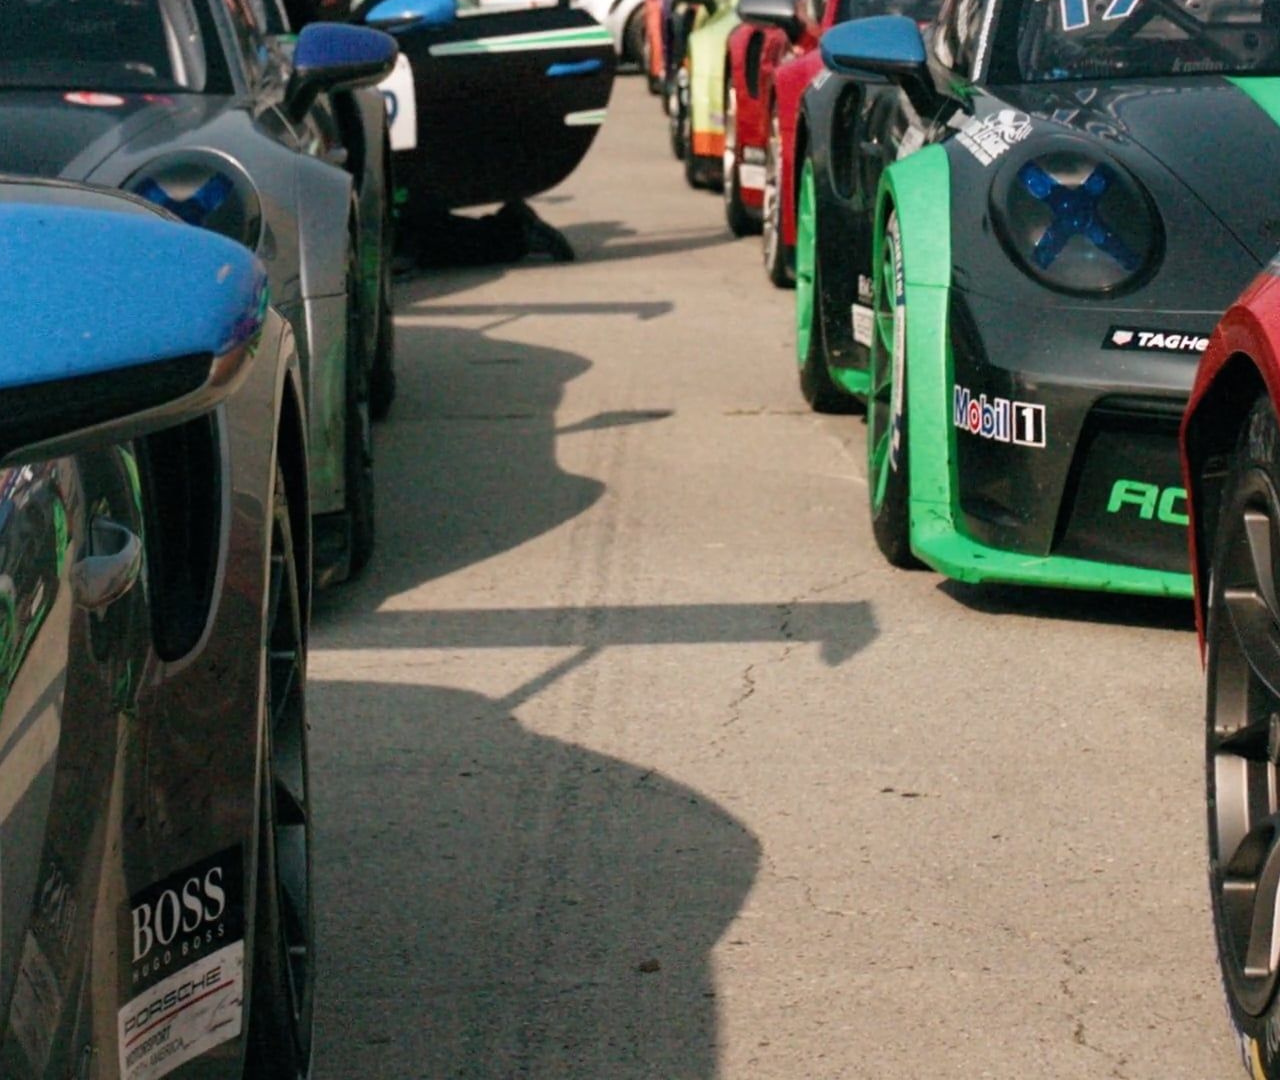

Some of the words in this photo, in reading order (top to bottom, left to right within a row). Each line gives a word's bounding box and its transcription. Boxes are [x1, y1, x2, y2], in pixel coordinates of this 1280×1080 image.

[953, 384, 1010, 443] Mobil
[1018, 405, 1043, 442] 1
[131, 866, 226, 964] BOSS
[132, 953, 172, 985] HUGO
[181, 922, 226, 957] BOSS
[123, 965, 222, 1038] PORSCHE
